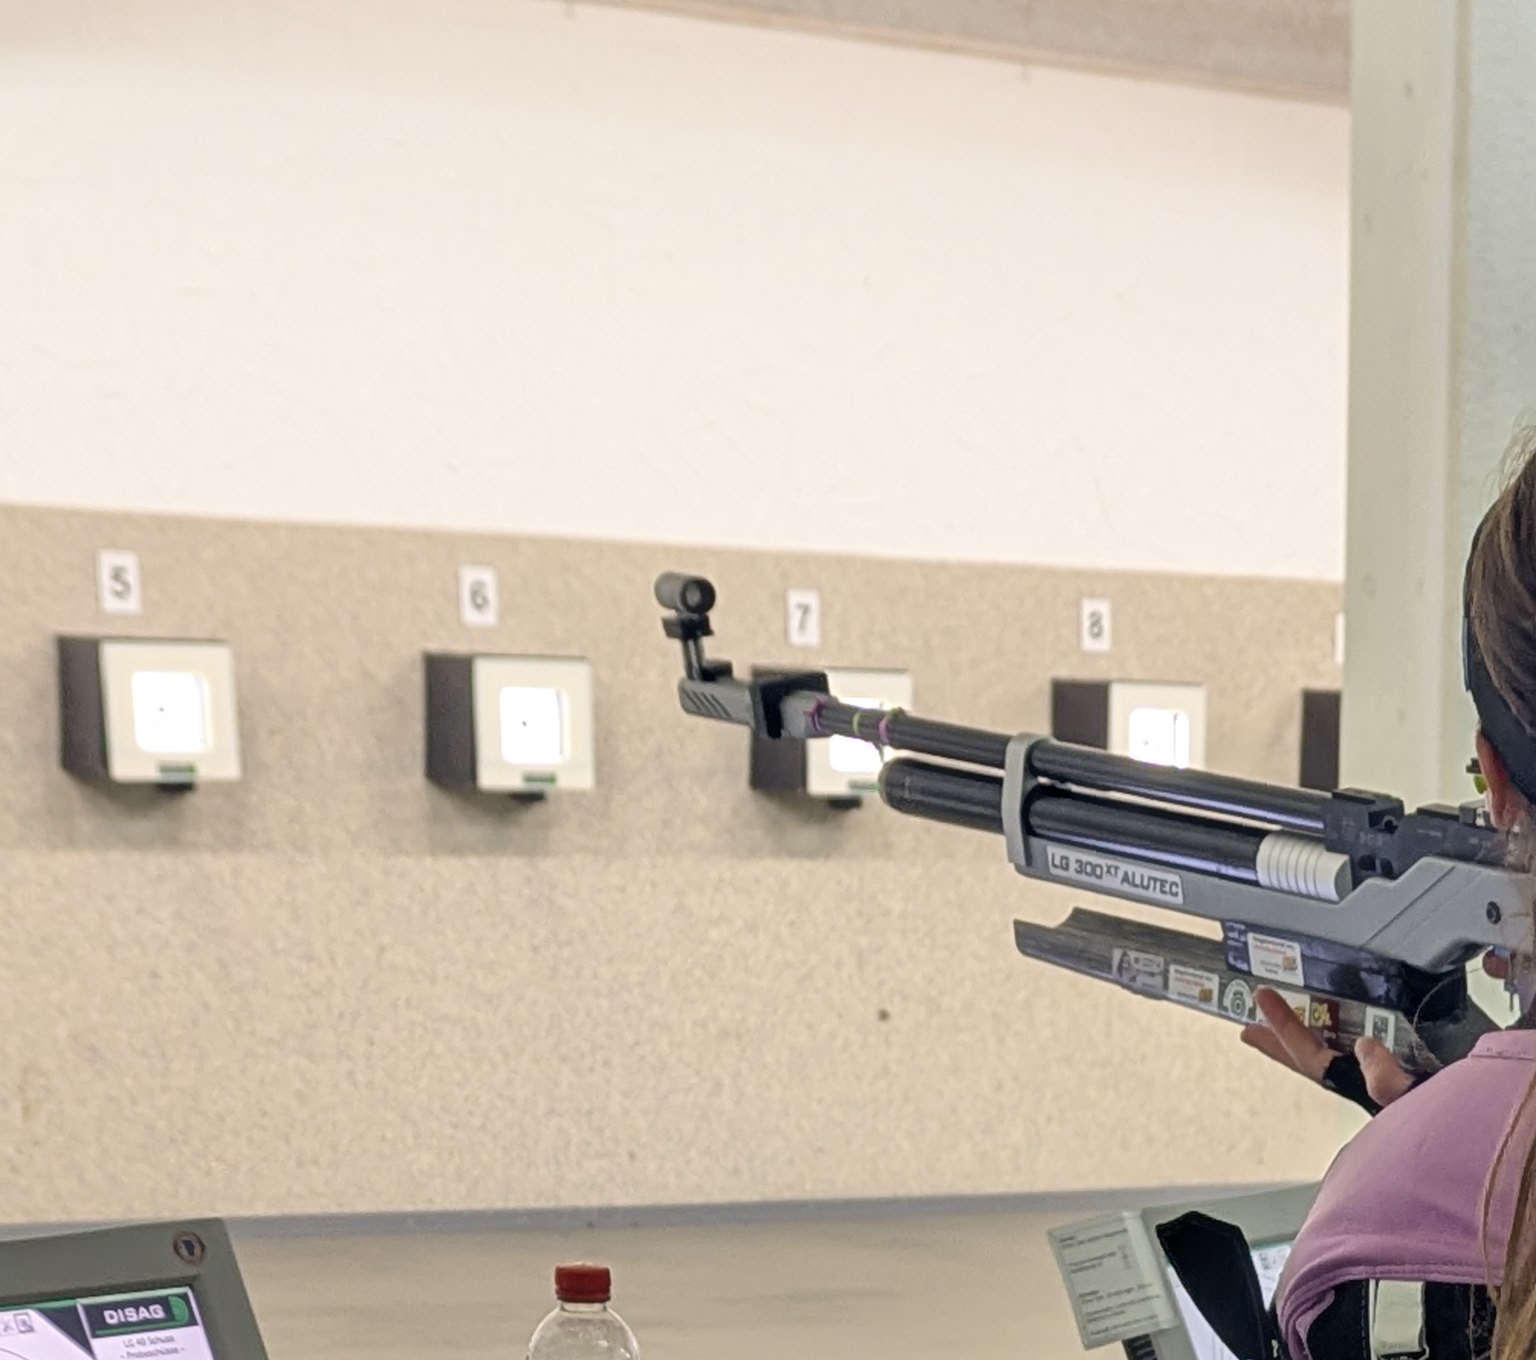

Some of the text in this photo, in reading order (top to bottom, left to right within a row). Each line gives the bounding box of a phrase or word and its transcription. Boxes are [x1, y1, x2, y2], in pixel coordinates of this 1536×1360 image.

[111, 565, 131, 600] 5
[470, 579, 490, 613] 6
[796, 603, 810, 634] 7
[1088, 610, 1103, 640] 8
[1051, 852, 1070, 872] LG
[1120, 870, 1180, 898] ALUTEC
[103, 1304, 167, 1325] DISAG
